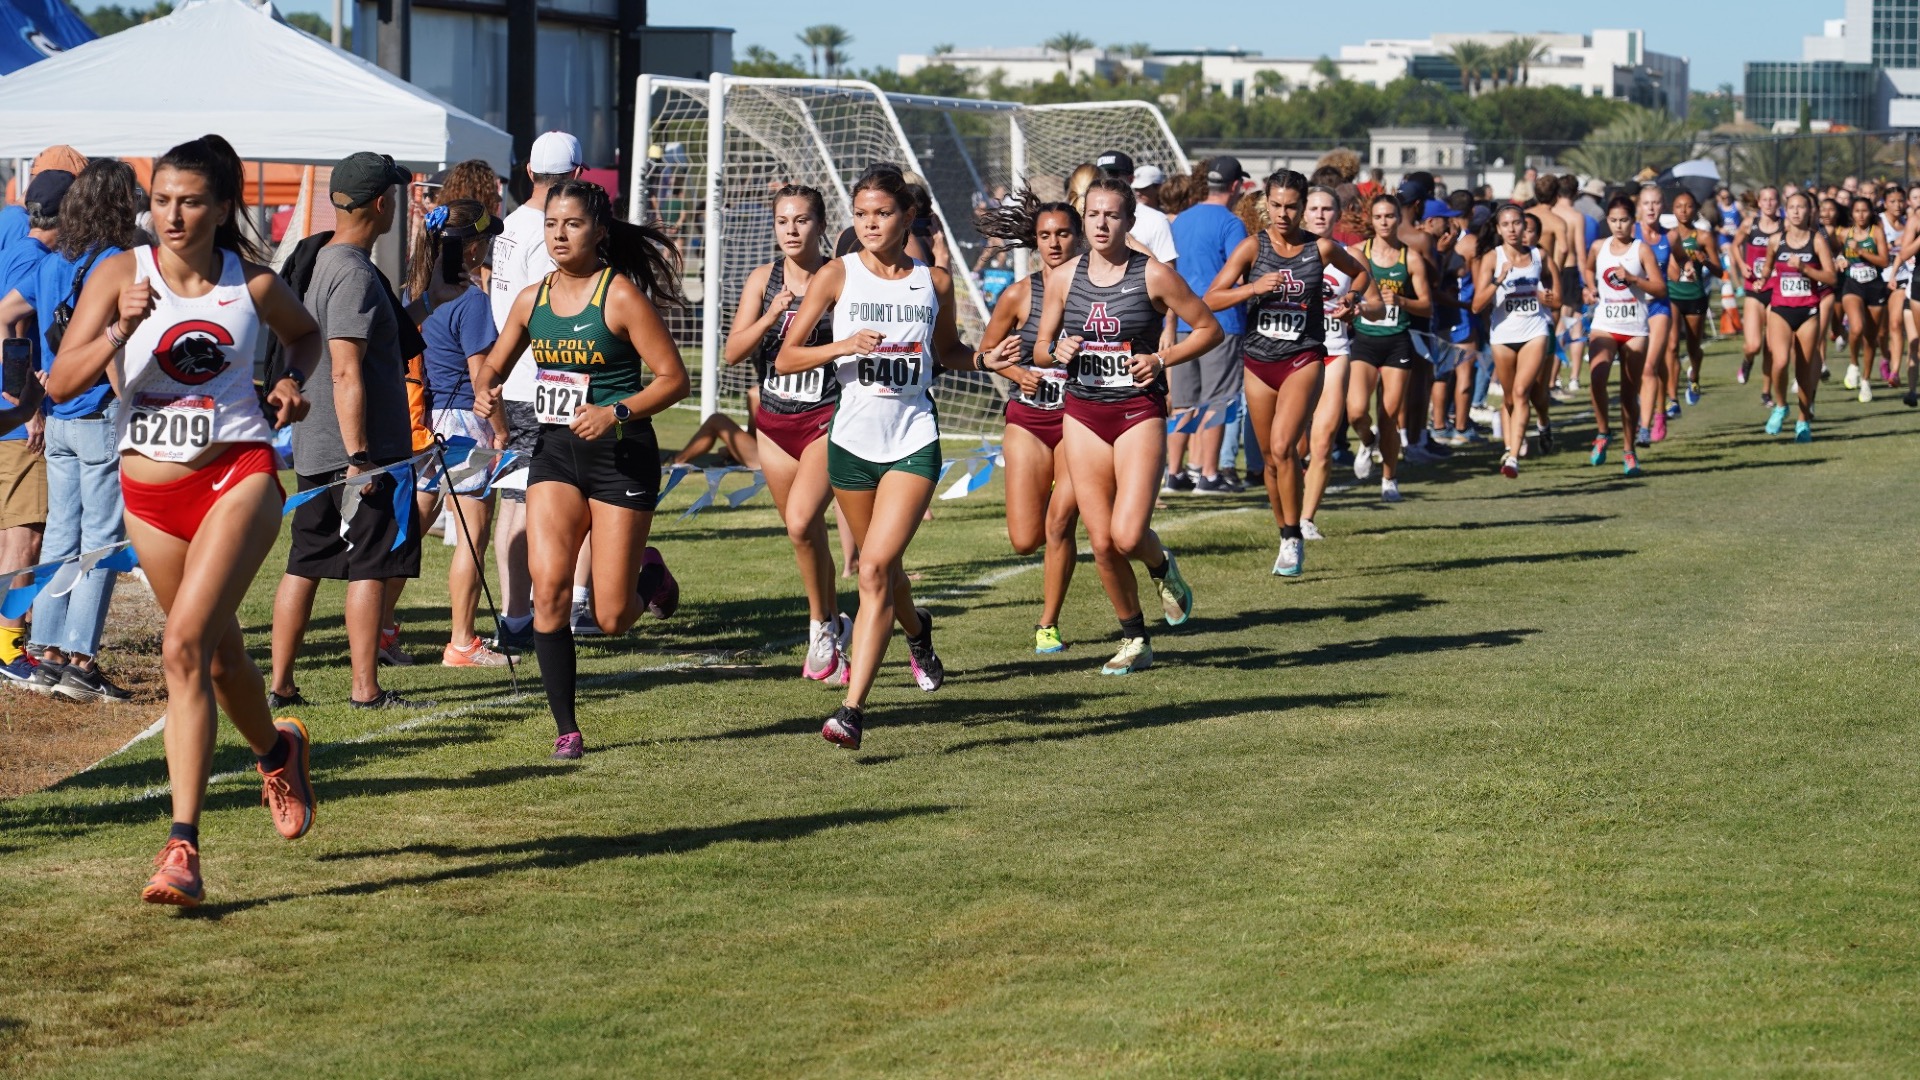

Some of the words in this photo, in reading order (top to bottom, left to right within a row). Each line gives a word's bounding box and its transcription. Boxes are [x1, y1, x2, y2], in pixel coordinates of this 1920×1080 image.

[849, 303, 893, 322] POINT
[897, 305, 934, 325] LOMA
[1505, 298, 1537, 313] 6286
[1605, 305, 1636, 318] 6204
[1259, 312, 1305, 333] 6102
[531, 339, 553, 350] CAL
[558, 339, 596, 351] POLY
[533, 350, 606, 365] OMONA
[1080, 354, 1130, 377] 6099
[858, 358, 921, 386] 6407
[536, 385, 583, 417] 6127
[130, 412, 210, 447] 6209
